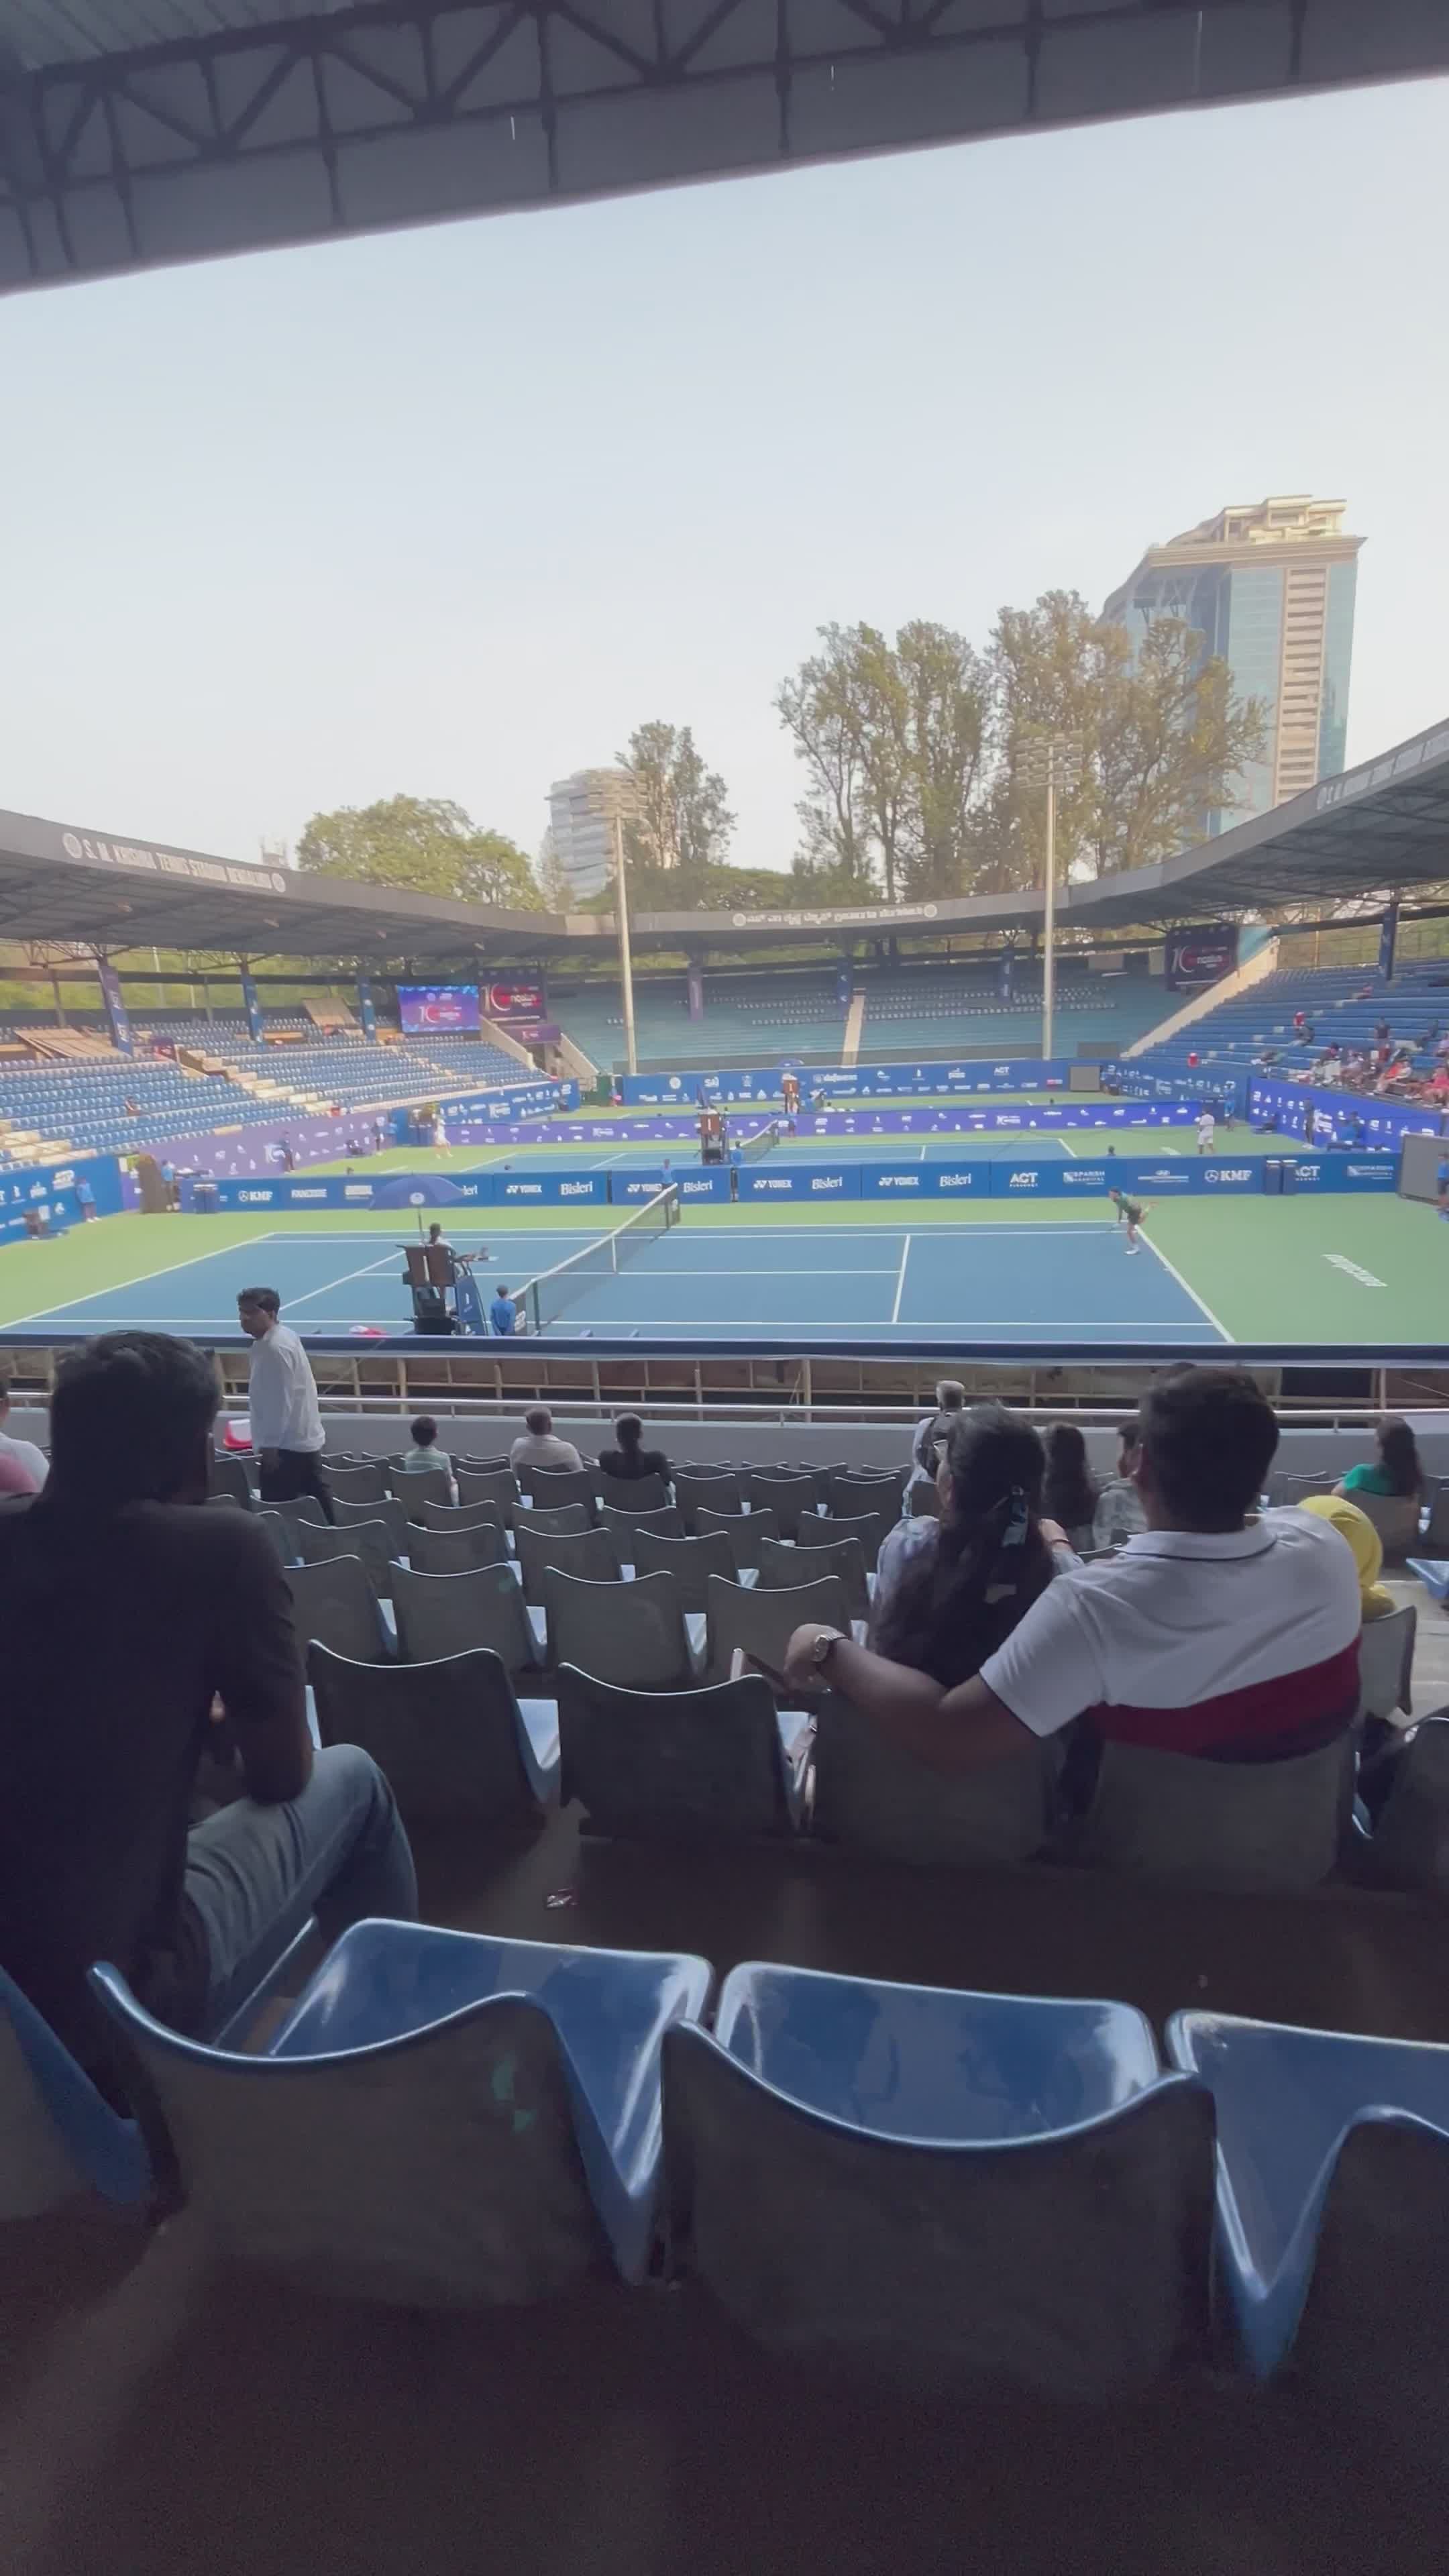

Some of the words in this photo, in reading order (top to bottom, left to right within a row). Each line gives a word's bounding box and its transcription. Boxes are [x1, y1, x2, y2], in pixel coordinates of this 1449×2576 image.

[939, 1173, 971, 1187] Bisleri
[1010, 1172, 1038, 1184] ACT
[1220, 1170, 1252, 1181] KMF
[559, 1181, 593, 1196] Bisleri
[683, 1180, 713, 1193] Bisleri
[769, 1179, 792, 1189] YONEX
[812, 1176, 843, 1189] Bisleri
[520, 1184, 543, 1194] YONEX
[249, 1190, 274, 1201] KMF
